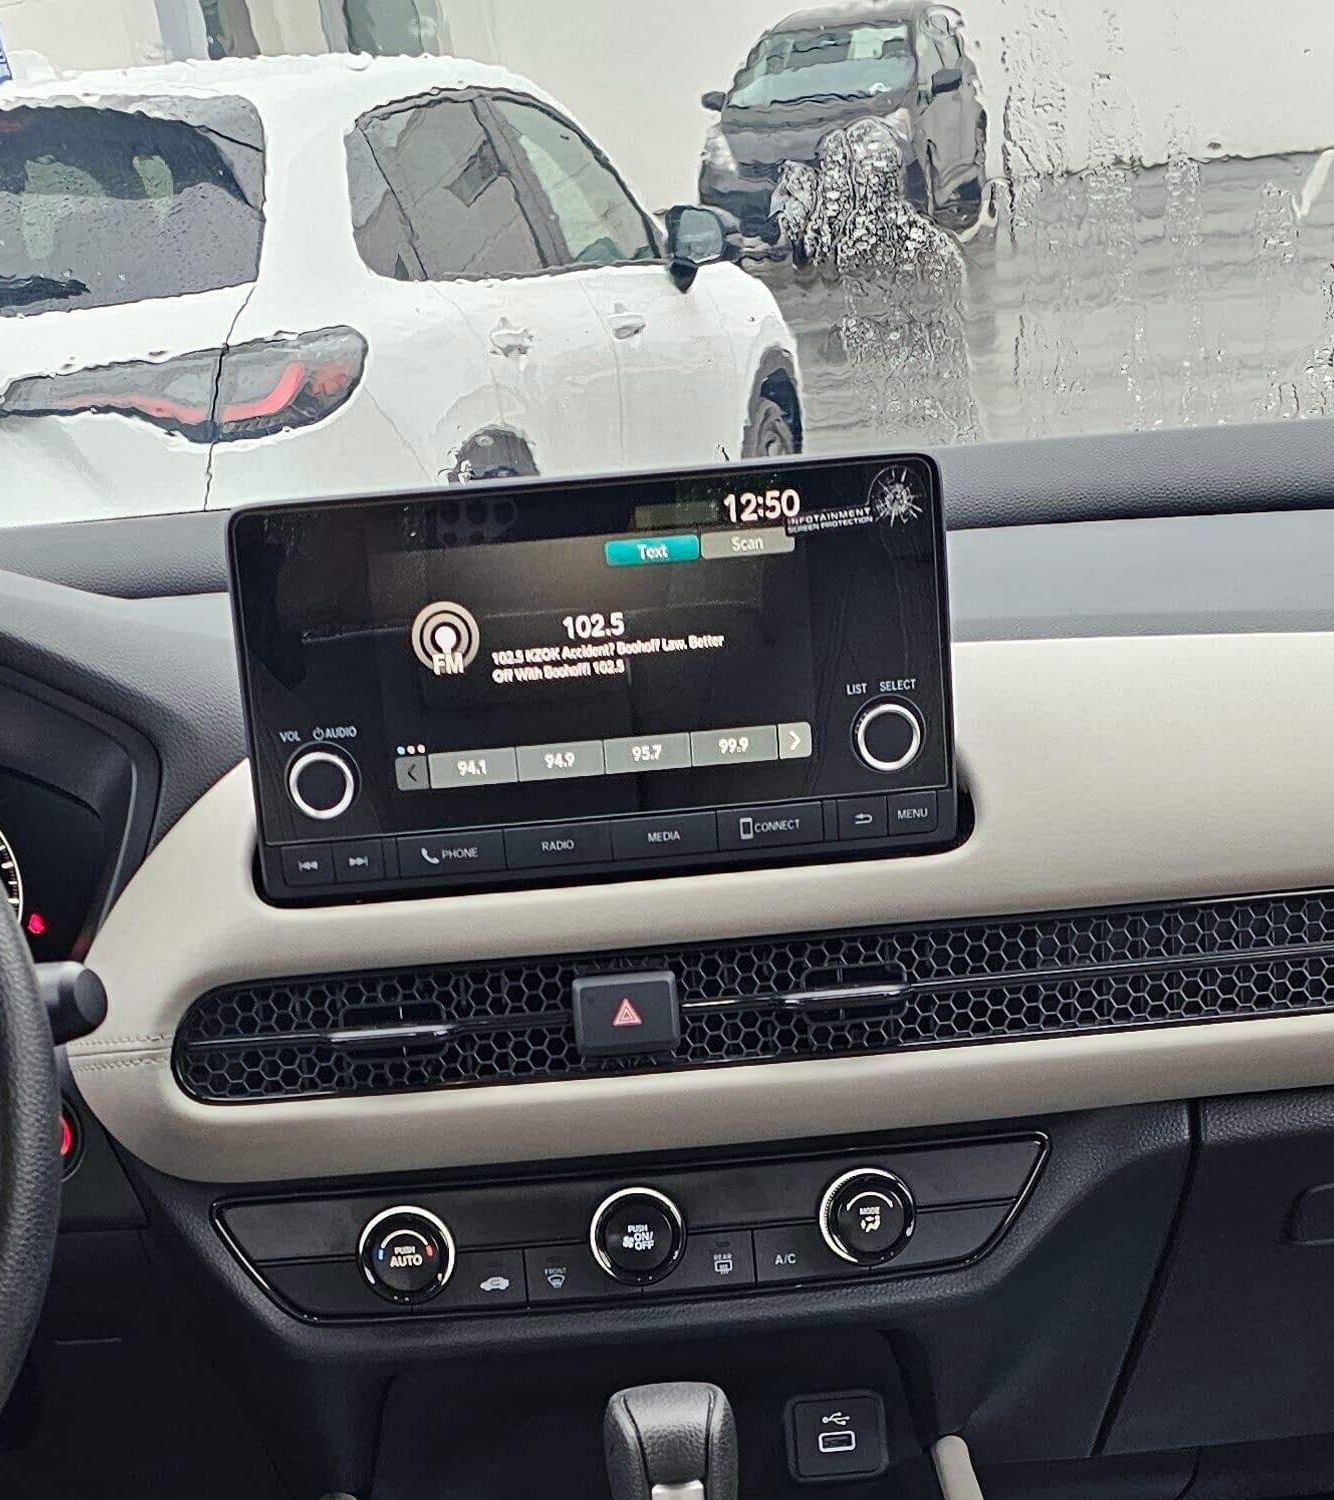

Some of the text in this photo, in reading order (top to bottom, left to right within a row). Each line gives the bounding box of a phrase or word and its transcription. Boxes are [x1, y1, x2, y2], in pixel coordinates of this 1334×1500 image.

[724, 489, 801, 522] 12:50
[788, 507, 871, 525] INFOTAINMENT
[637, 543, 669, 560] Text
[731, 535, 764, 552] Scan
[562, 612, 625, 640] 102.5
[492, 650, 524, 665] 102.5
[689, 634, 725, 649] Better
[432, 652, 465, 676] FM
[592, 658, 624, 676] 102.5
[846, 679, 916, 695] LIST SELECT
[279, 725, 357, 742] VOL AUDIO
[456, 737, 749, 776] 94.1 94.9 95.7 99.9
[897, 807, 929, 820] MENU
[754, 818, 801, 833] CONNECT
[647, 830, 681, 843] MEDIA
[541, 839, 575, 851] RADIO
[441, 847, 478, 860] PHONE
[628, 1224, 648, 1233] PUSH
[634, 1240, 655, 1251] OFF
[390, 1254, 424, 1268] AUTO
[713, 1252, 732, 1261] REAR
[775, 1252, 797, 1266] A/C
